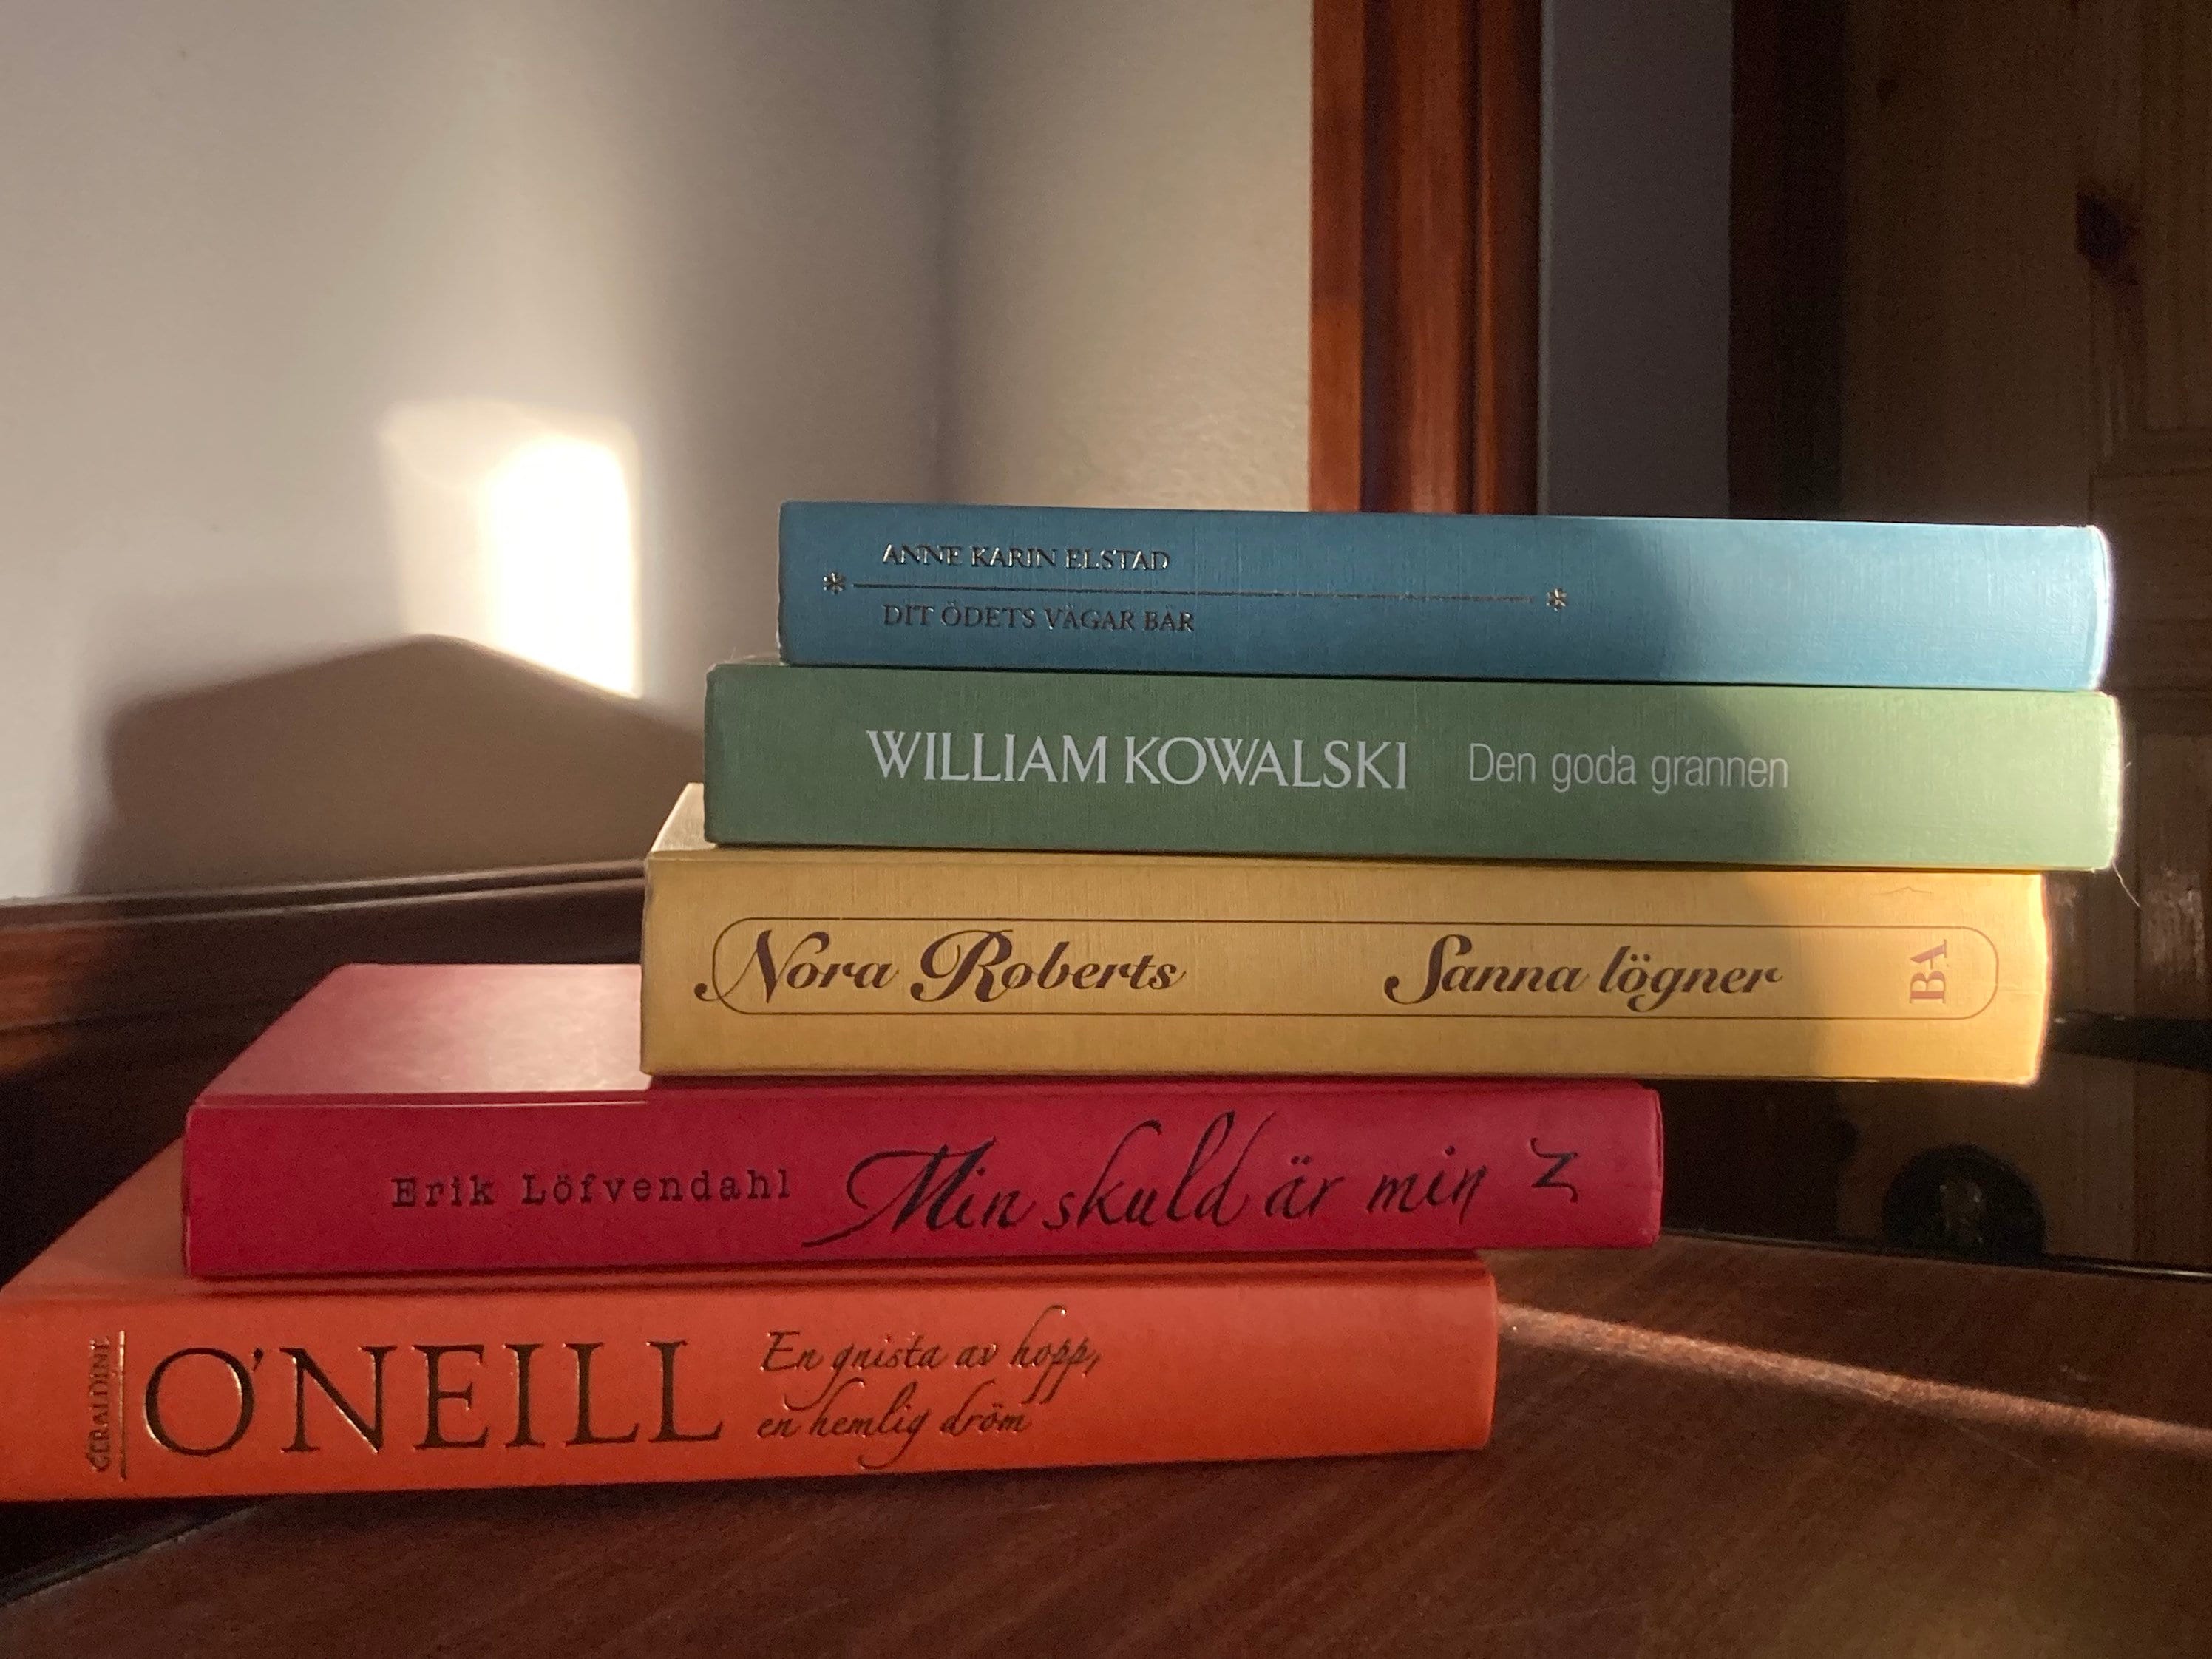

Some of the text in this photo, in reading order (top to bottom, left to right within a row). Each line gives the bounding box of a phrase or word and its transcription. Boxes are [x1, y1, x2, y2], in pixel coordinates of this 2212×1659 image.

[883, 543, 1170, 571] ANNE KARIN ELSTAD
[883, 603, 934, 627] DIT
[940, 600, 1035, 629] ÖDETS
[1043, 602, 1133, 631] VÄGAR
[866, 730, 1409, 790] WILLIAM KOWALSKI
[1468, 743, 1789, 794] Den goda grannen
[693, 929, 1187, 1003] Nora Roberts
[1384, 934, 1783, 1012] Sanna lögner
[1909, 938, 1947, 1004] BA
[391, 1168, 792, 1207] Erik Löfvendahl
[802, 1110, 1487, 1248] Min skuld är min
[759, 1304, 1102, 1411] En gnista av hopp,
[756, 1377, 1034, 1470] en hemlig dröm
